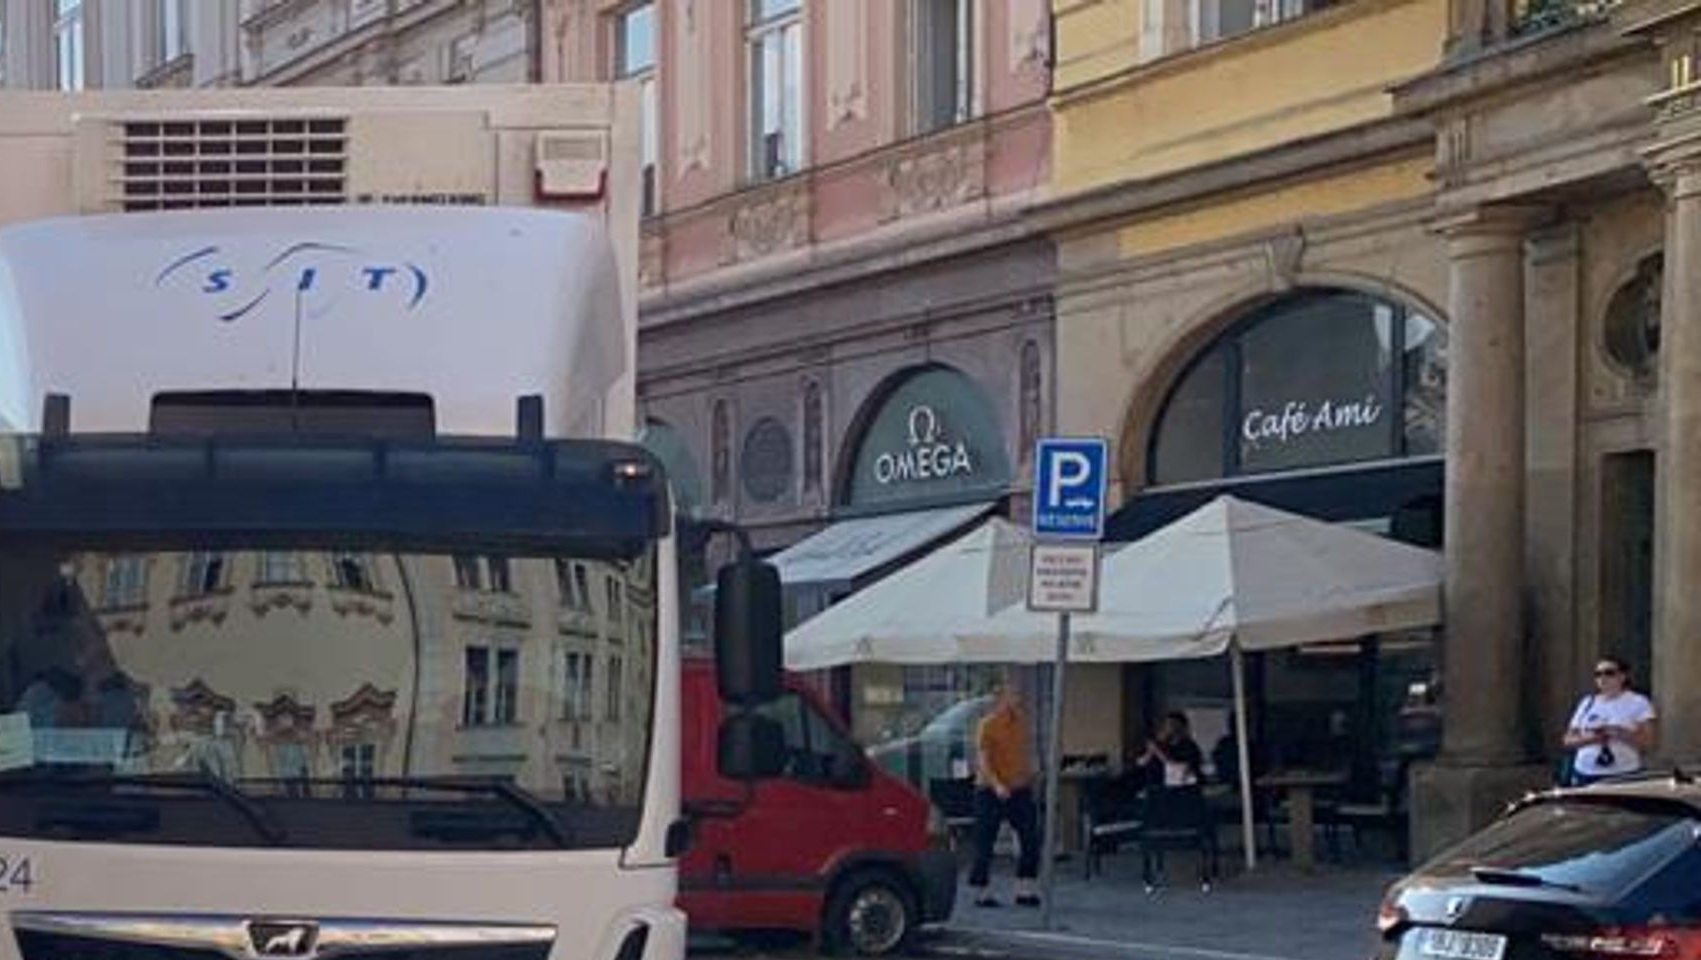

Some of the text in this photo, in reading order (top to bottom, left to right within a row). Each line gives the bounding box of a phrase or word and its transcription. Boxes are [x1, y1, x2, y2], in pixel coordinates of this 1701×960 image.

[1242, 394, 1382, 441] Café Ami
[875, 443, 972, 484] OMEGA
[1049, 451, 1091, 507] P
